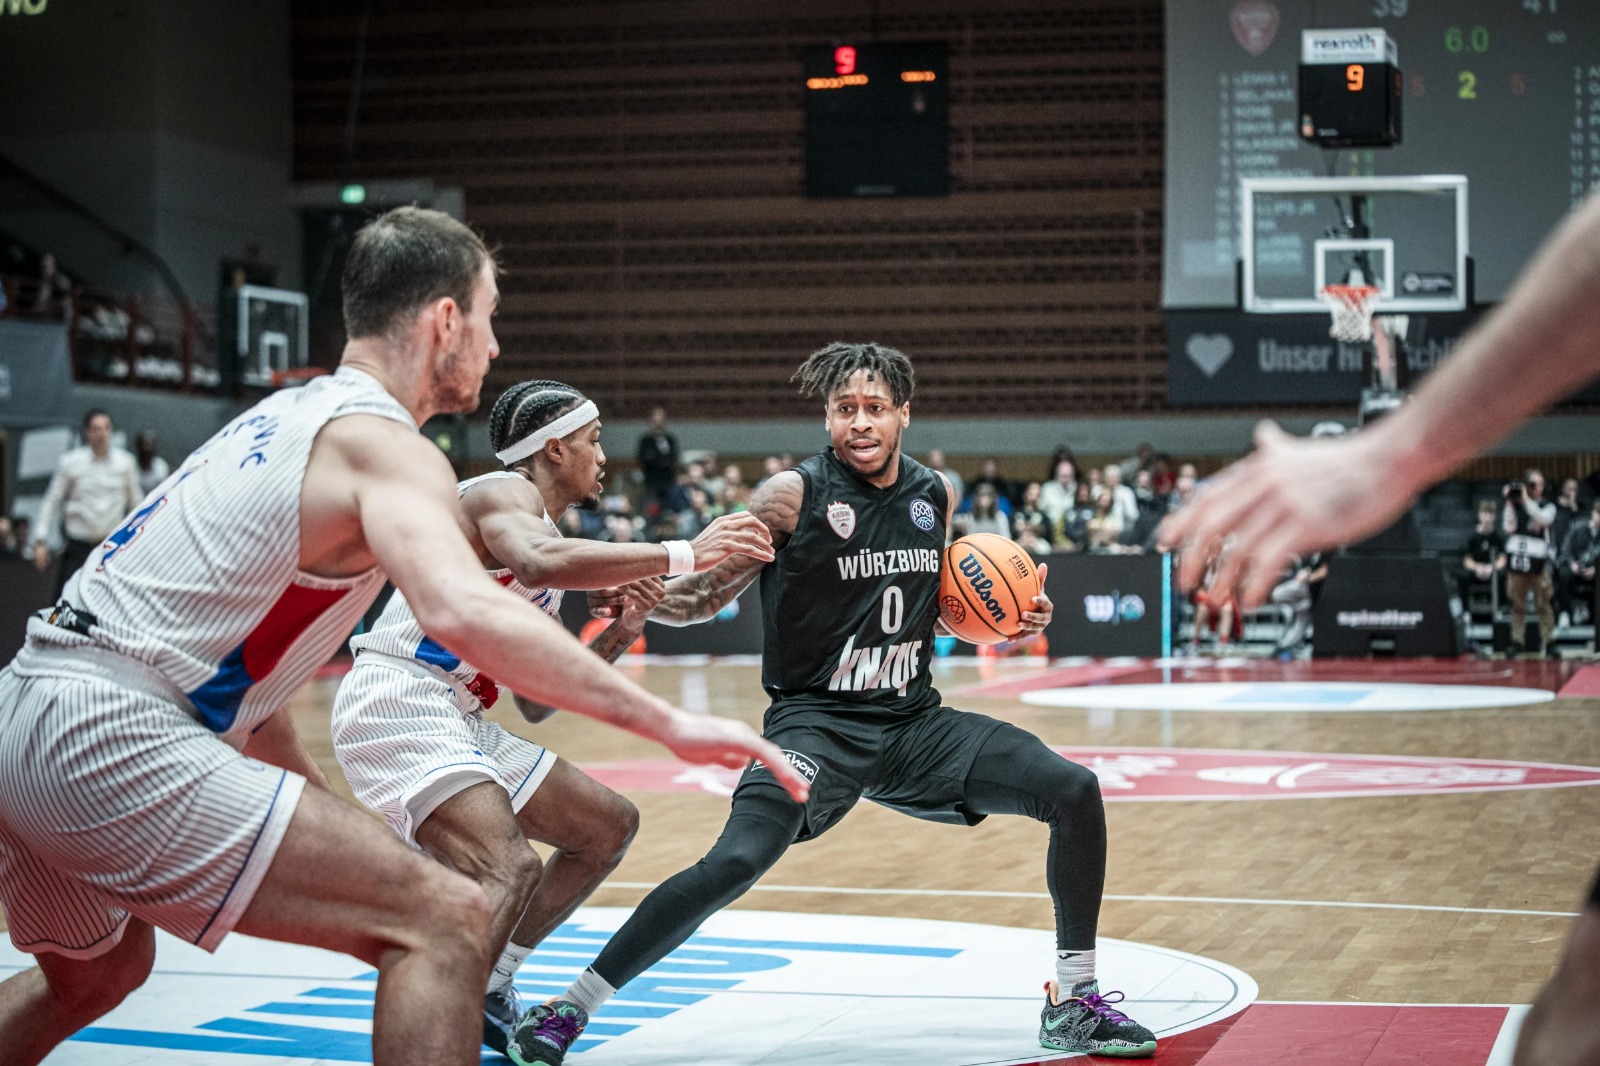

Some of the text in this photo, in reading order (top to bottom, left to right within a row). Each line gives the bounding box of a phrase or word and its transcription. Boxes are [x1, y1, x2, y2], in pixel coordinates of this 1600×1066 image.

[834, 45, 857, 75] 9
[1346, 64, 1364, 91] 9
[1457, 70, 1477, 100] 2
[1257, 339, 1332, 372] Unser
[837, 548, 939, 580] WÜRZBURG
[1012, 554, 1029, 578] FIBA
[959, 553, 1007, 624] Wilson
[881, 586, 904, 635] 0
[828, 634, 923, 697] KNAUF
